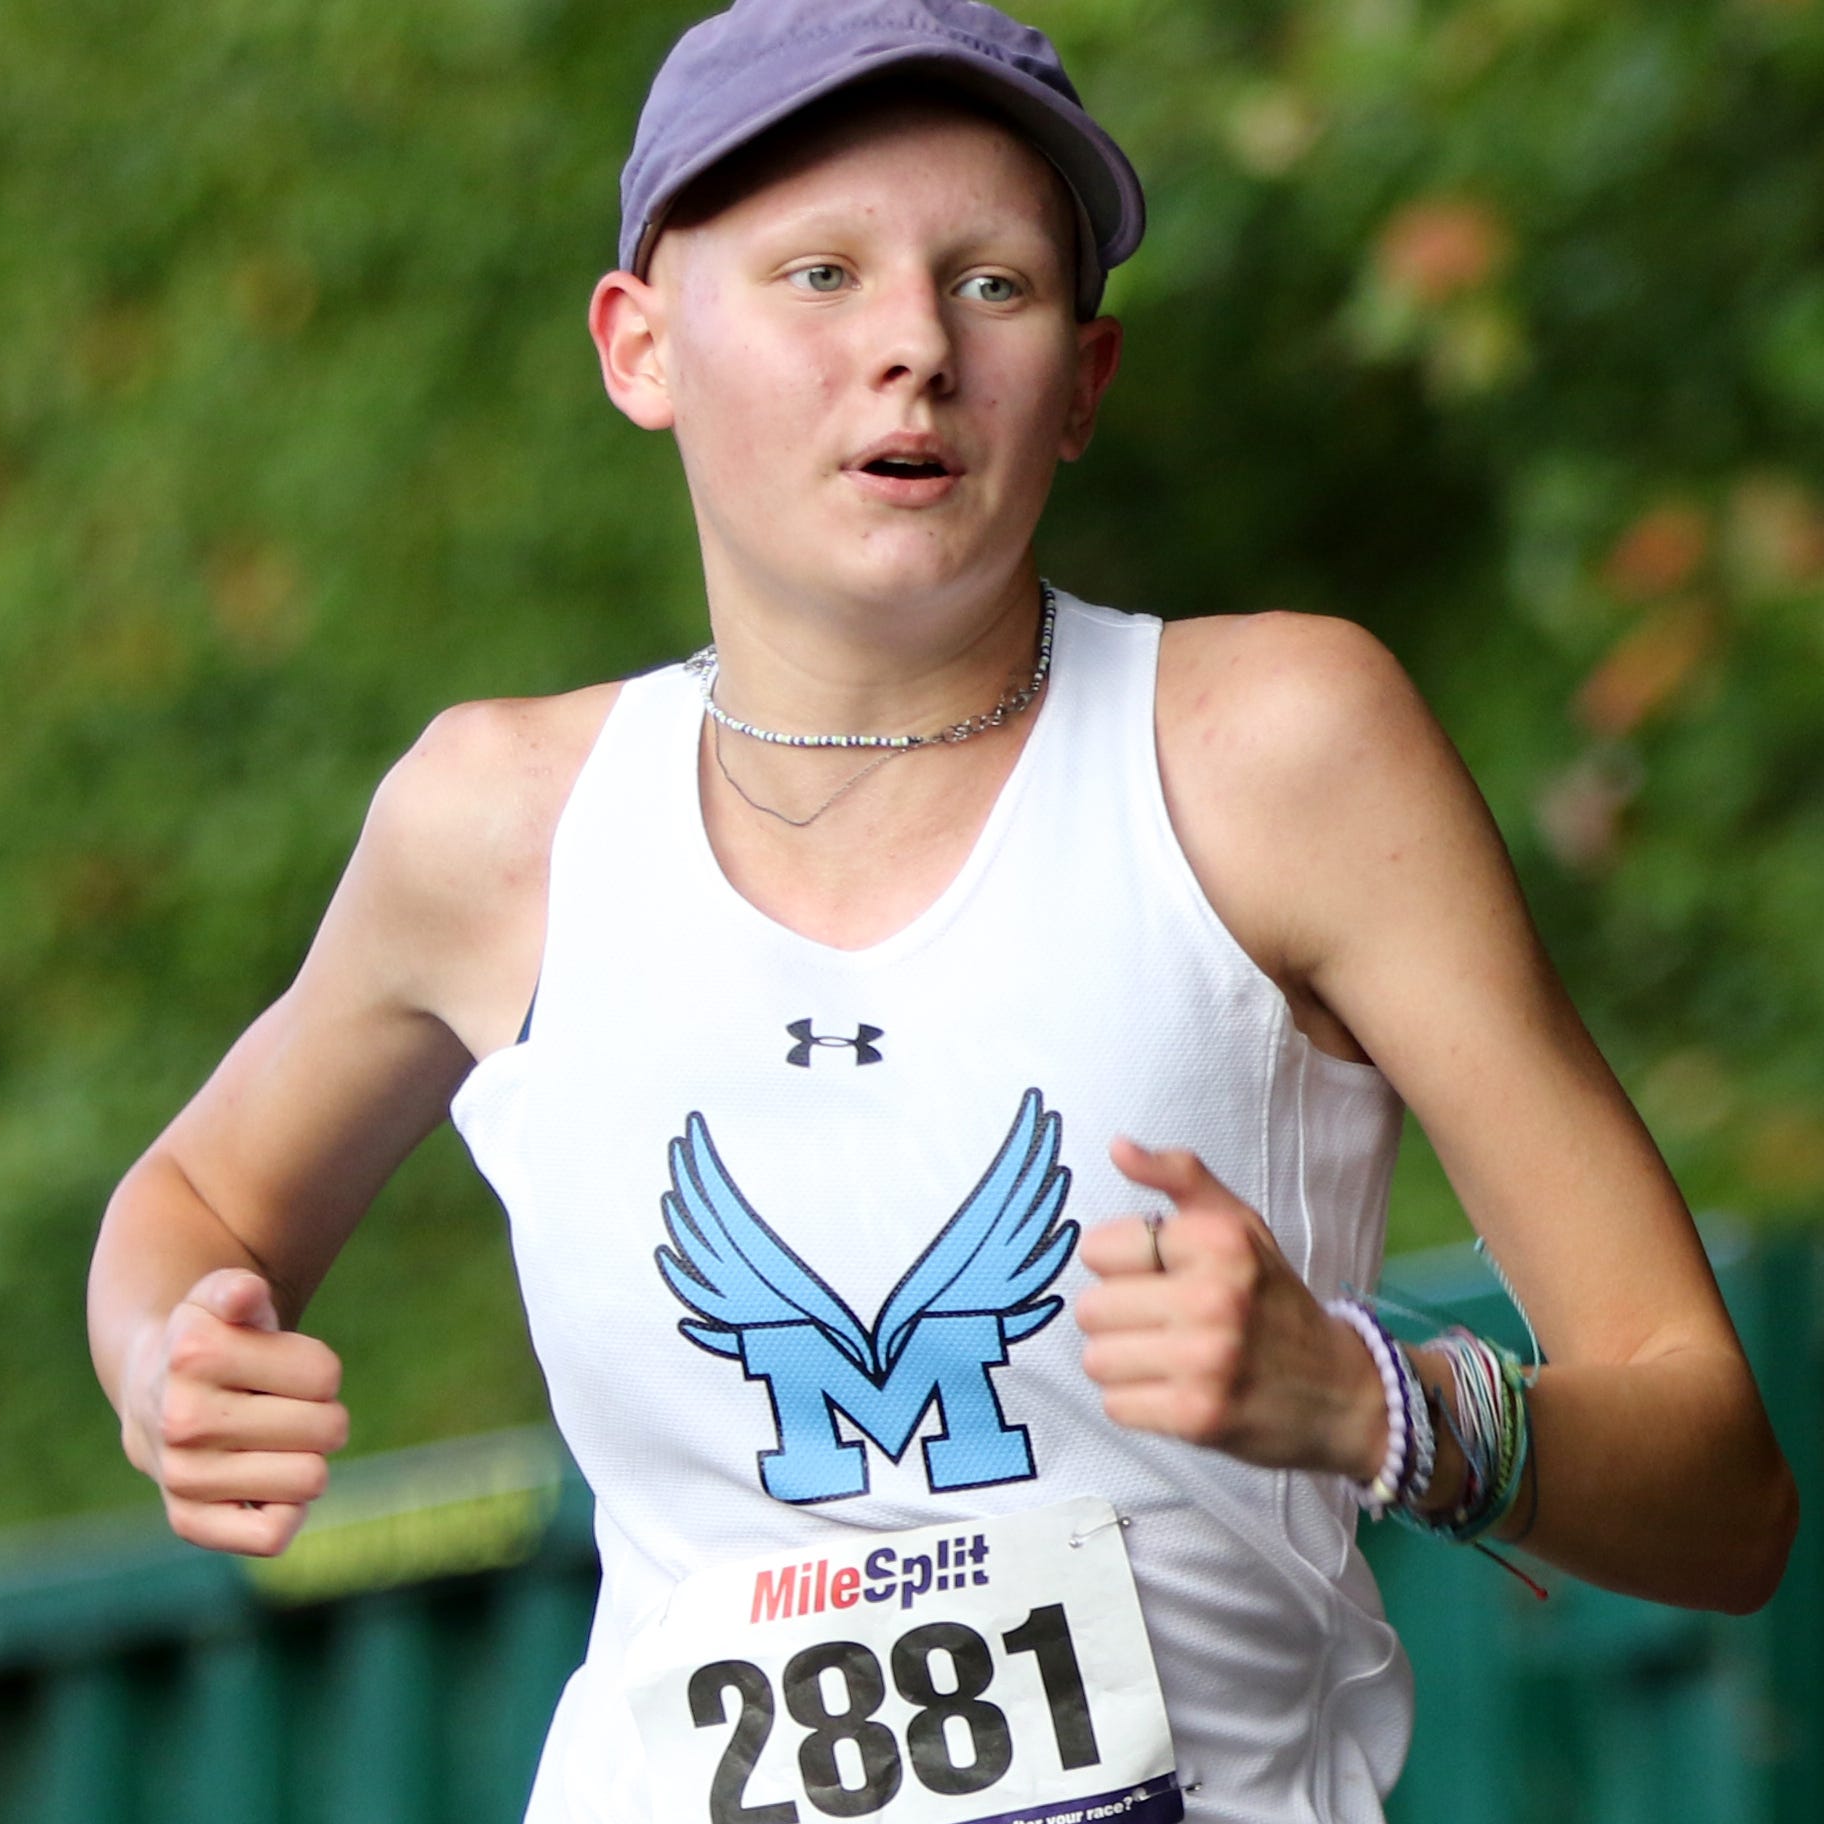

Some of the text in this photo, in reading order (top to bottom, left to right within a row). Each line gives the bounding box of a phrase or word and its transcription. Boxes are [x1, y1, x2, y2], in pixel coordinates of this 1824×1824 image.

[736, 1312, 1037, 1506] M
[749, 1533, 990, 1624] MileSplit
[1086, 1796, 1133, 1821] race?
